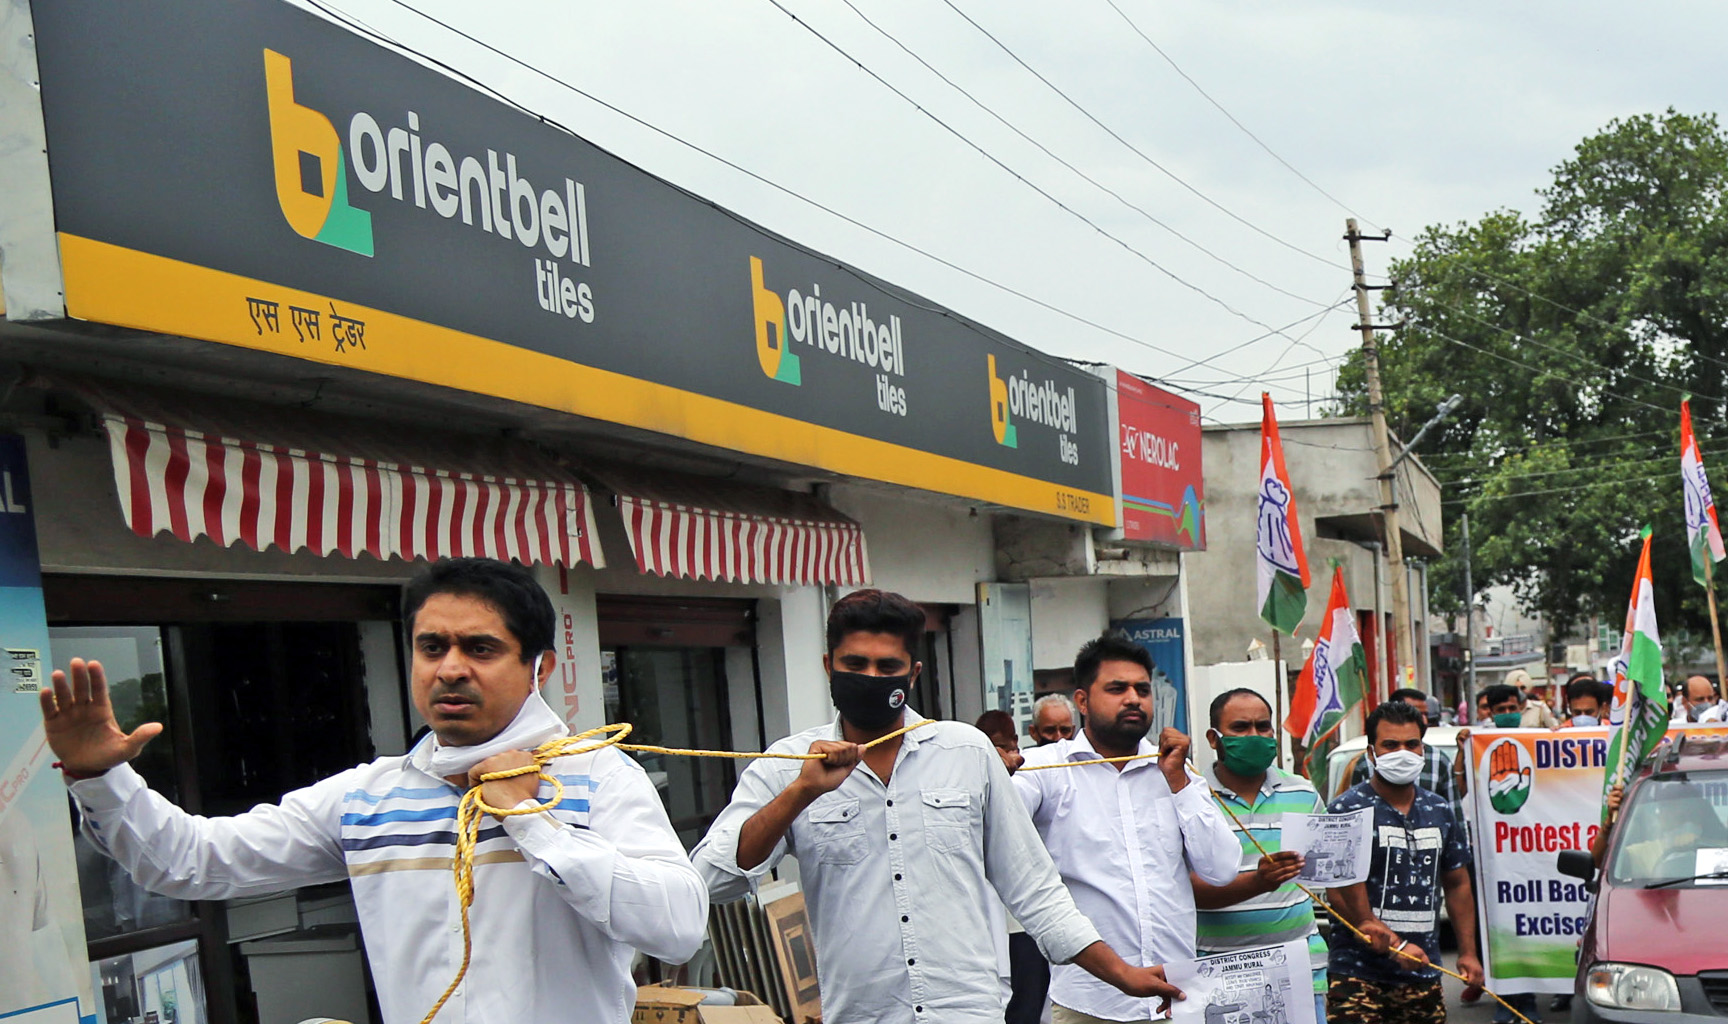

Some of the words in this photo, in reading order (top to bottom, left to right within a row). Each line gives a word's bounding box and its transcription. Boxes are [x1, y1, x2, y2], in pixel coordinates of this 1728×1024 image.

[348, 110, 591, 268] orientbell
[535, 258, 594, 324] tiles
[246, 297, 279, 335] एस
[289, 304, 321, 342] एस
[788, 283, 904, 377] orientbell
[877, 374, 907, 417] tiles
[1009, 371, 1077, 434] orientbell
[1060, 434, 1079, 466] tiles
[1139, 430, 1180, 471] NEROLAC
[563, 613, 575, 660] PRO
[1134, 628, 1180, 640] ASTRAL
[1536, 739, 1608, 769] DISTR
[1495, 821, 1581, 853] Protest
[1497, 880, 1542, 903] Roll
[1549, 879, 1590, 903] Bac
[1515, 913, 1587, 936] Excise
[1210, 954, 1237, 966] DISTRICT
[1238, 950, 1271, 961] CONGRESS
[1221, 962, 1243, 972] JAMMU
[1244, 960, 1263, 969] RURAL
